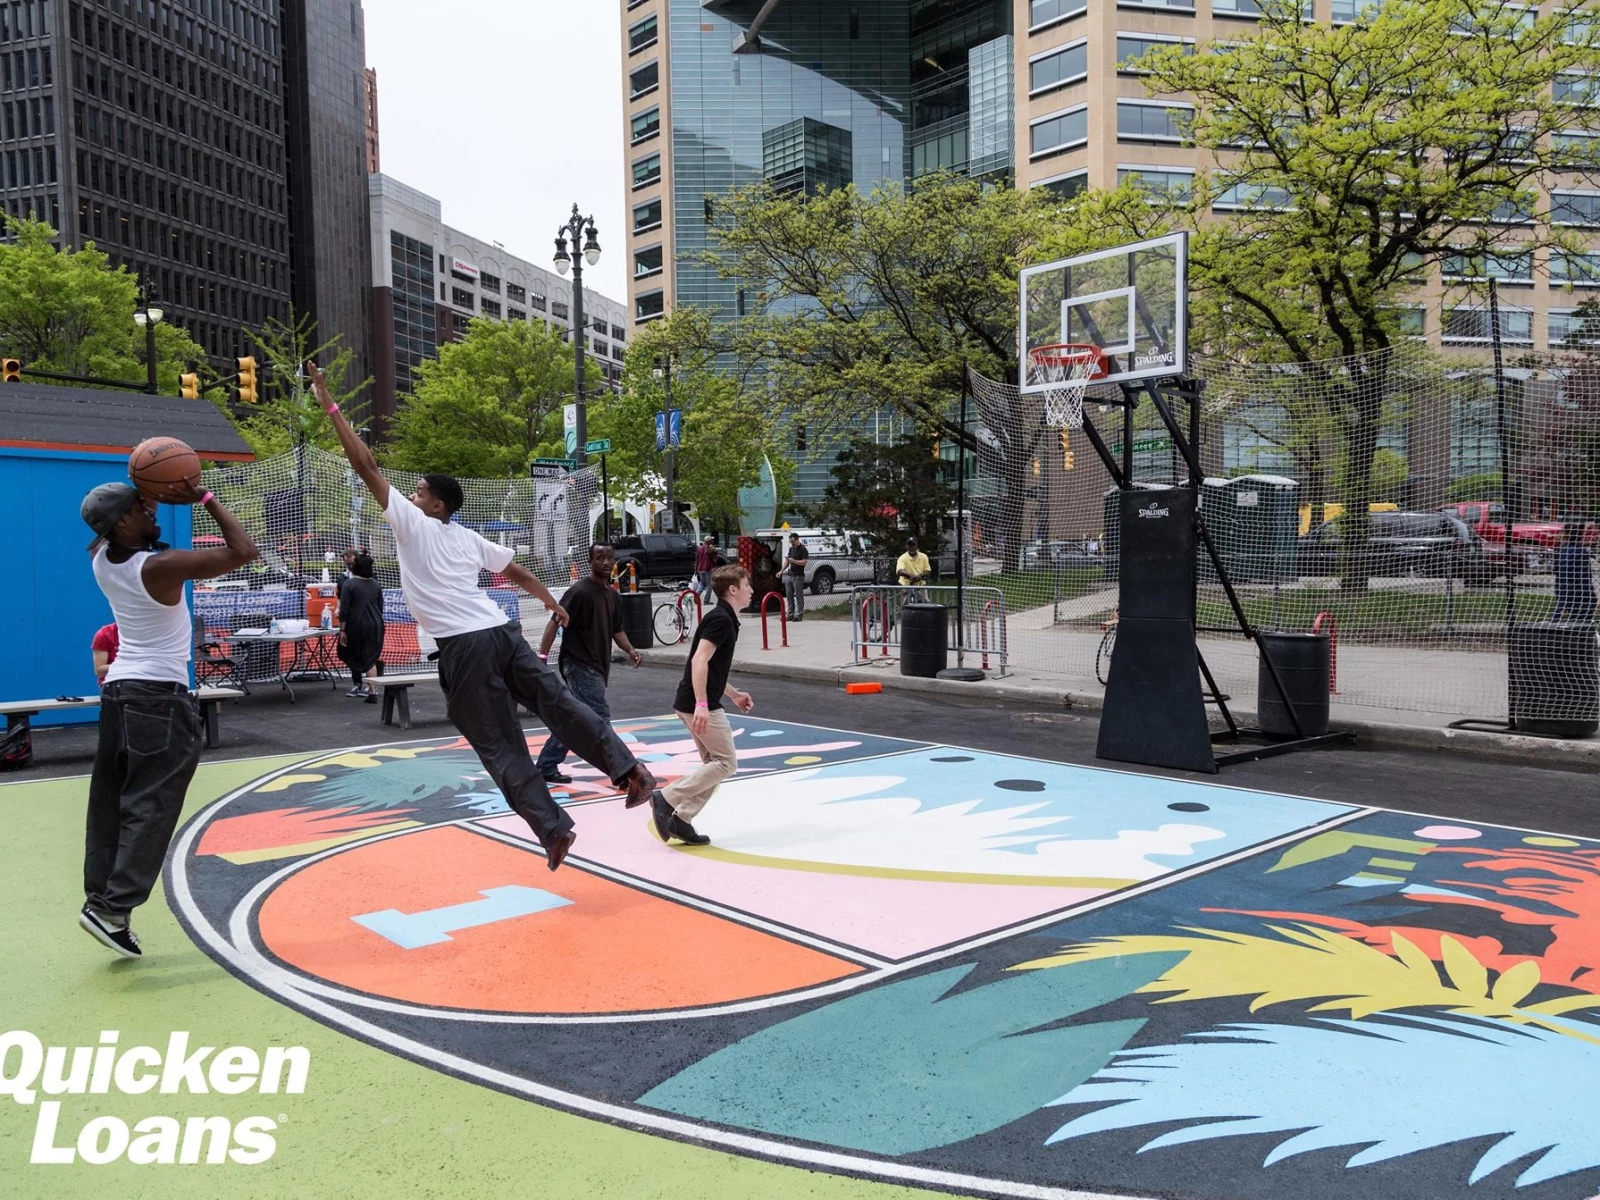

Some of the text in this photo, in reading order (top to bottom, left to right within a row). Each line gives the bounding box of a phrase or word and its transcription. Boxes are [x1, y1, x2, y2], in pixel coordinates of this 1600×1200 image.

[1134, 352, 1174, 367] SPALDING
[534, 467, 560, 476] ONE WAY
[1138, 507, 1169, 518] SPALDING
[194, 607, 234, 617] PORTS
